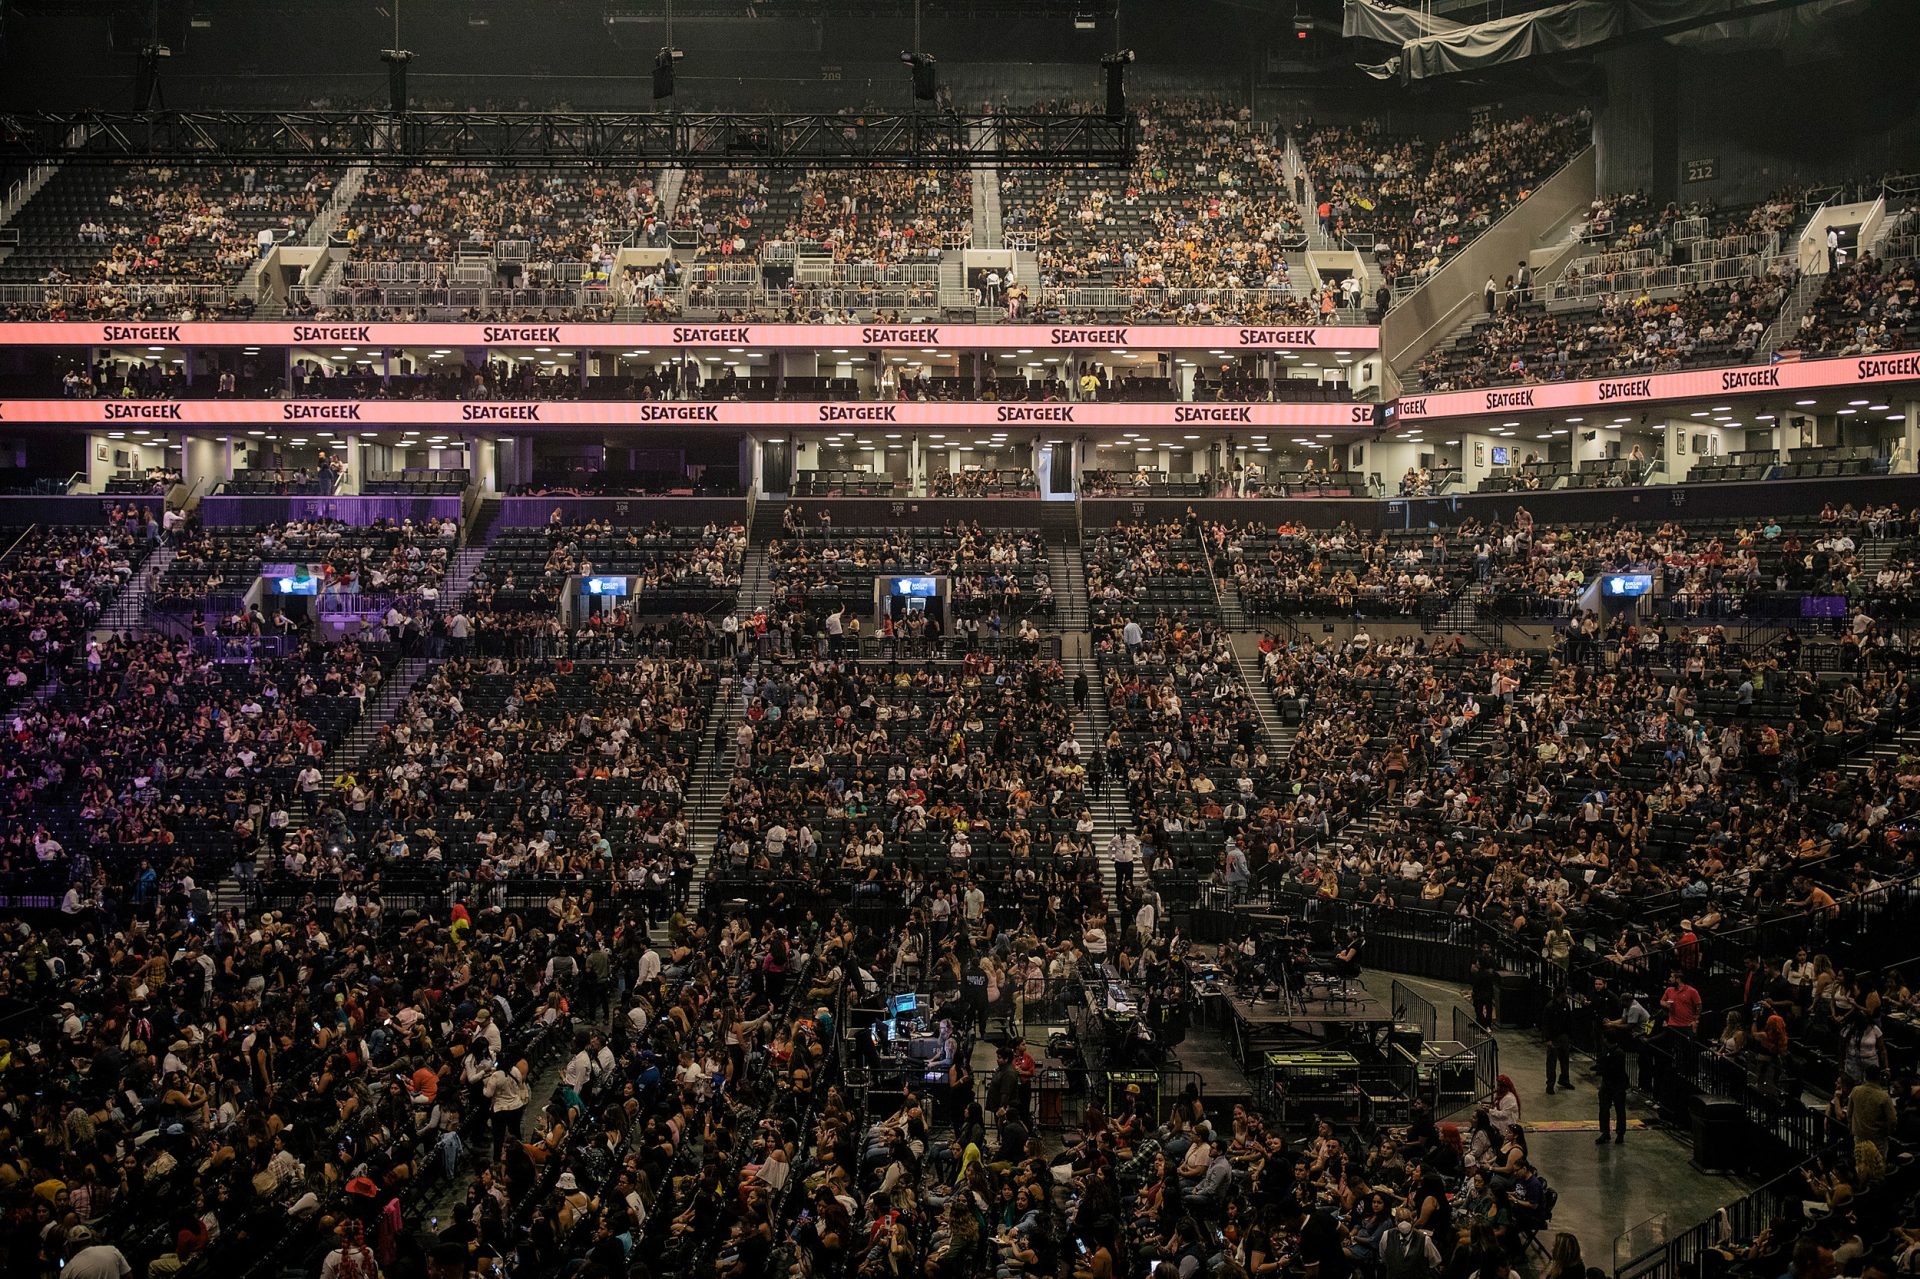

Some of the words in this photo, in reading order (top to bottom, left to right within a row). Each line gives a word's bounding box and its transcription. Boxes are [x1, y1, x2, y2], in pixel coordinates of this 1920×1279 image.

[1689, 167, 1713, 180] 212
[104, 326, 180, 341] SEATGEEK
[294, 326, 370, 341] SEATGEEK
[484, 326, 560, 342] SEATGEEK
[674, 327, 749, 342] SEATGEEK
[863, 327, 938, 342] SEATGEEK
[1052, 327, 1127, 342] SEATGEEK
[1240, 328, 1315, 343] SEATGEEK
[1858, 356, 1920, 379] SEATGEEK
[1722, 368, 1779, 390] SEATGEEK
[1599, 379, 1651, 400] SEATGEEK
[1486, 389, 1534, 409] SEATGEEK
[105, 403, 181, 419] SEATGEEK
[284, 403, 360, 419] SEATGEEK
[463, 404, 539, 420] SEATGEEK
[641, 405, 717, 420] SEATGEEK
[820, 405, 895, 421] SEATGEEK
[998, 406, 1073, 421] SEATGEEK
[1176, 406, 1251, 421] SEATGEEK
